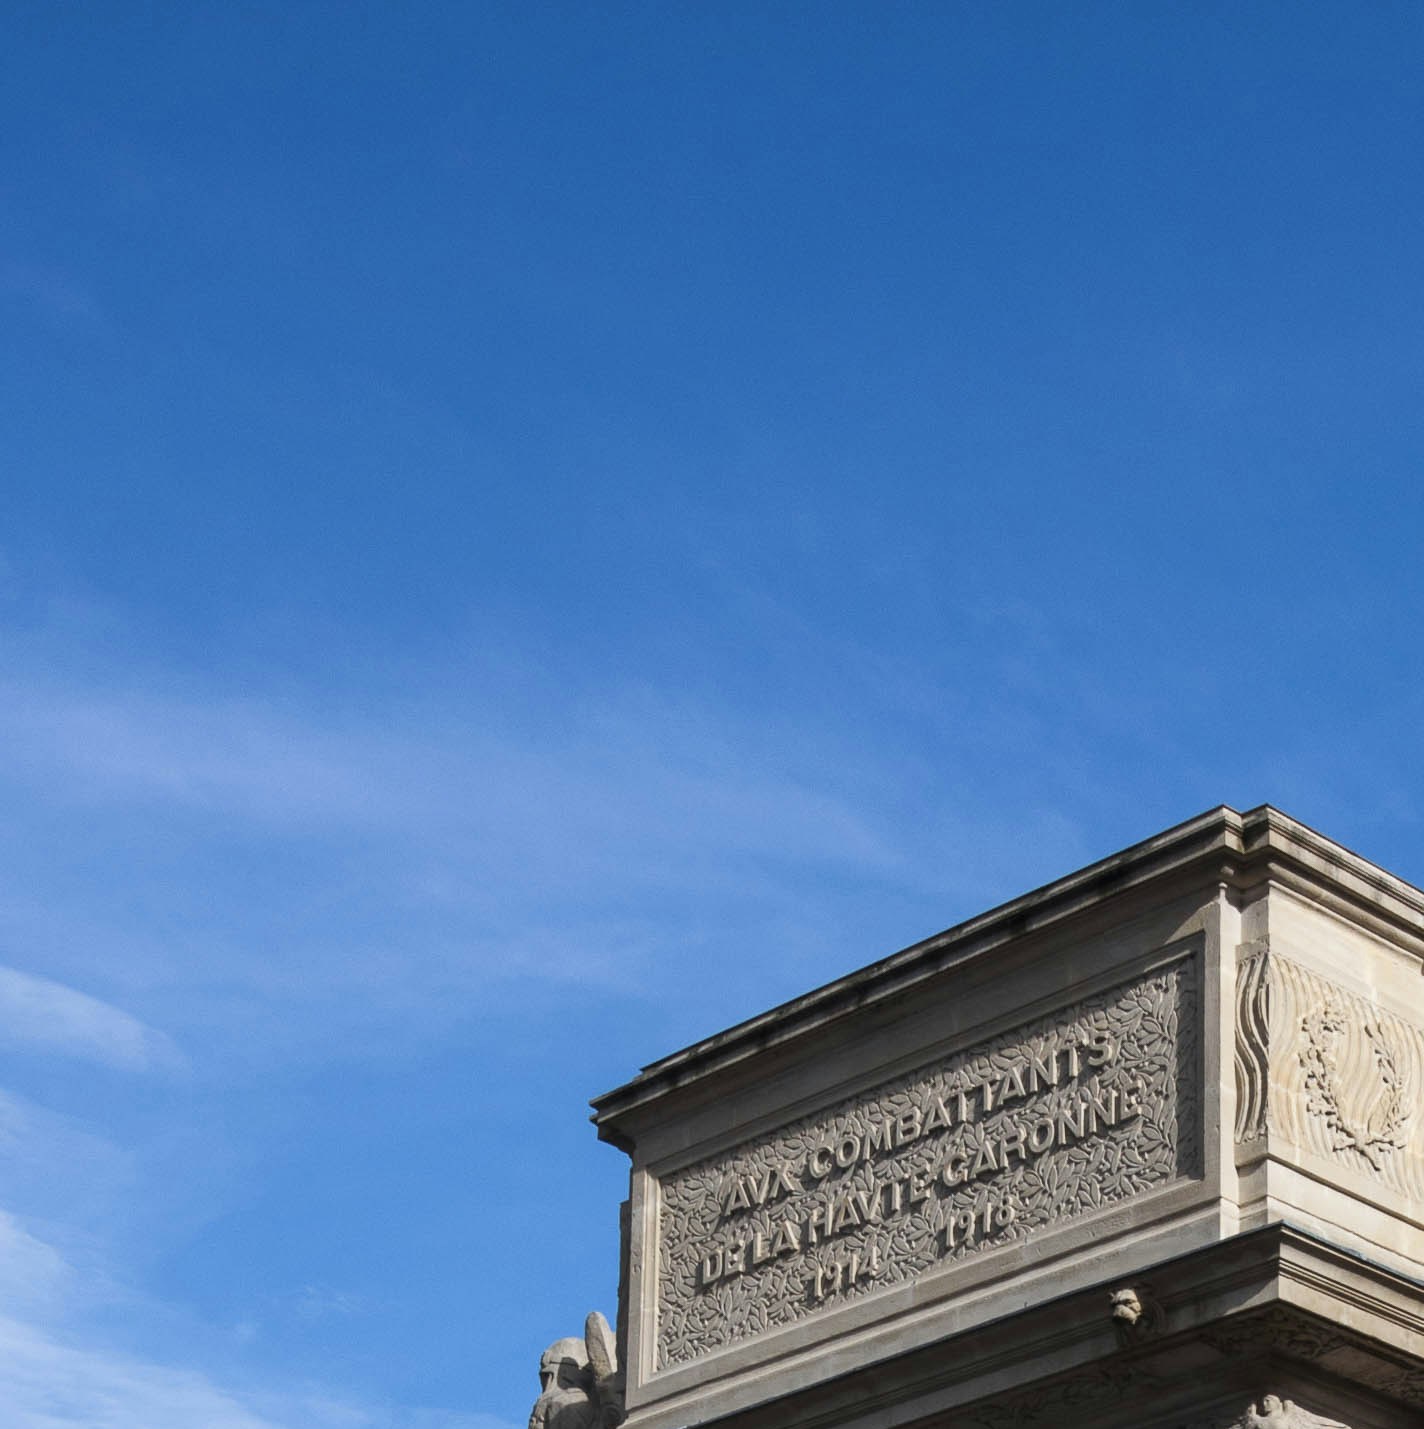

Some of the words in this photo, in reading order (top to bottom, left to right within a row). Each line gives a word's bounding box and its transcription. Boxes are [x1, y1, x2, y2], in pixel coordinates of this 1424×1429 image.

[809, 1030, 1113, 1179] COMBATTANTS
[702, 1239, 745, 1284] DE
[752, 1219, 800, 1264] LA
[808, 1160, 932, 1244] HAVTE
[943, 1078, 1143, 1187] GARONNE
[813, 1240, 879, 1298] 1914
[945, 1195, 1016, 1248] 1918
